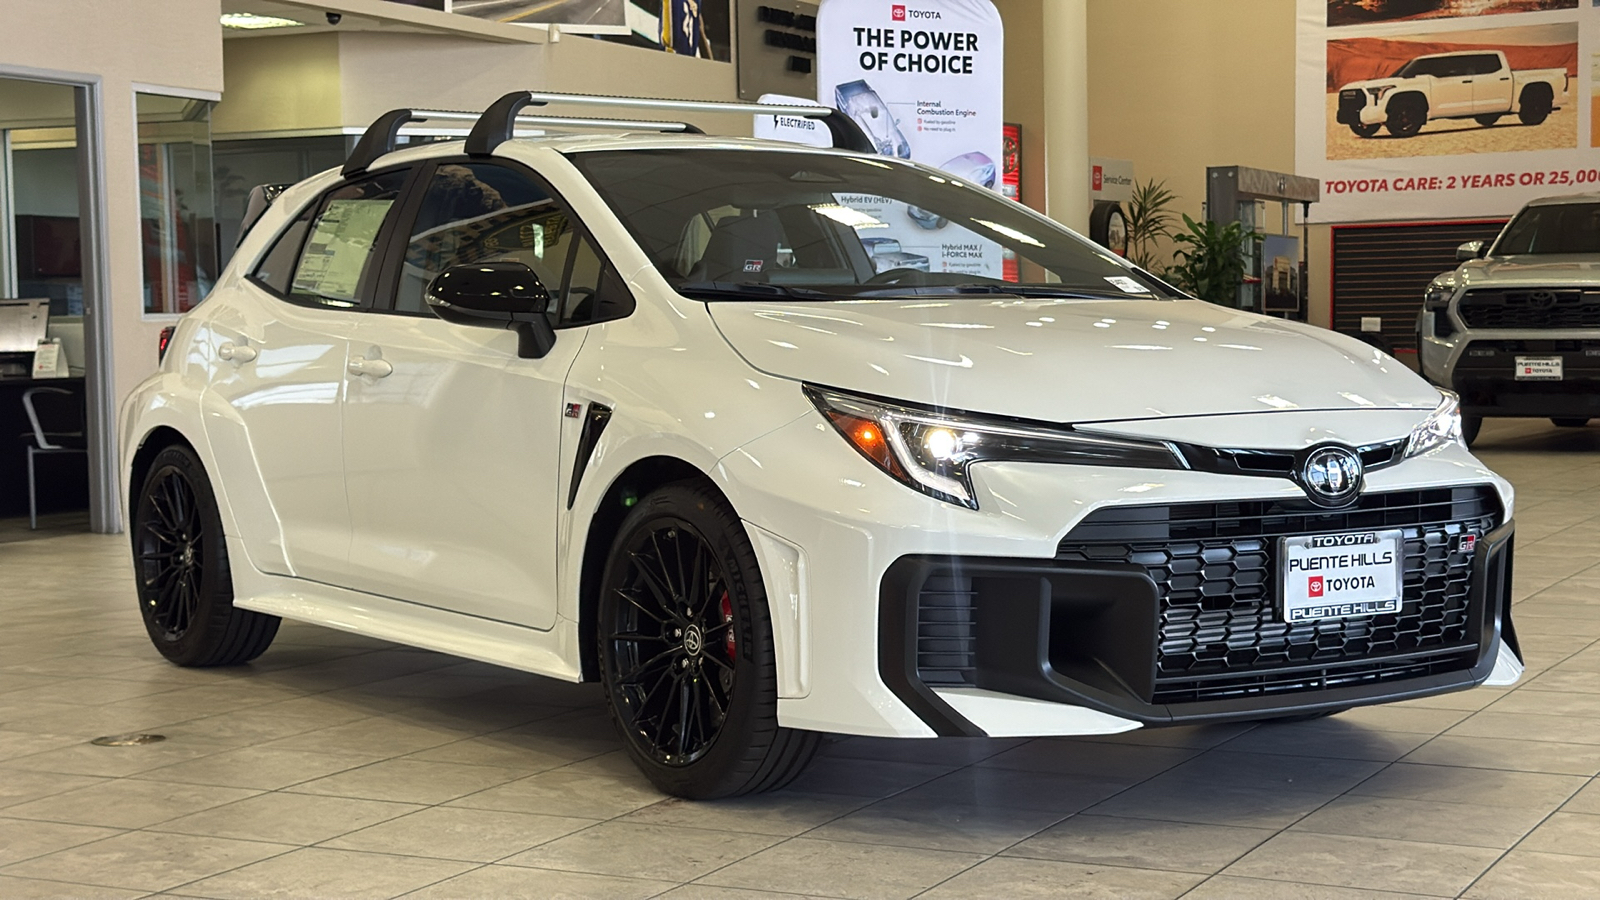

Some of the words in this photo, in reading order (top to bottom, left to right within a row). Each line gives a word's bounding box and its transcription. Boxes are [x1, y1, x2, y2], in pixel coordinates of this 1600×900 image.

[908, 10, 941, 20] TOYOTA
[853, 27, 895, 48] THE
[900, 30, 979, 51] POWER
[859, 51, 888, 71] OF
[893, 53, 973, 74] CHOICE
[916, 100, 942, 108] Internal
[916, 108, 955, 116] Combustion
[955, 109, 977, 118] Engine
[780, 117, 816, 130] ELECTRIFIED
[1325, 178, 1389, 194] TOYOTA
[1393, 176, 1443, 191] CARE:
[1446, 175, 1457, 189] 2
[1461, 173, 1515, 189] YEARS
[1519, 171, 1545, 186] OR
[1548, 169, 1600, 186] 25,00
[841, 196, 863, 204] Hybrid
[864, 196, 873, 204] EV
[941, 244, 962, 252] Hybrid
[1314, 533, 1374, 547] TOYOTA
[1459, 538, 1475, 551] GR
[1289, 555, 1349, 572] PUENTE
[1351, 551, 1393, 567] HILLS
[1326, 575, 1375, 592] TOYOTA
[1291, 604, 1351, 620] PUENTE
[1353, 600, 1396, 614] HILLS
